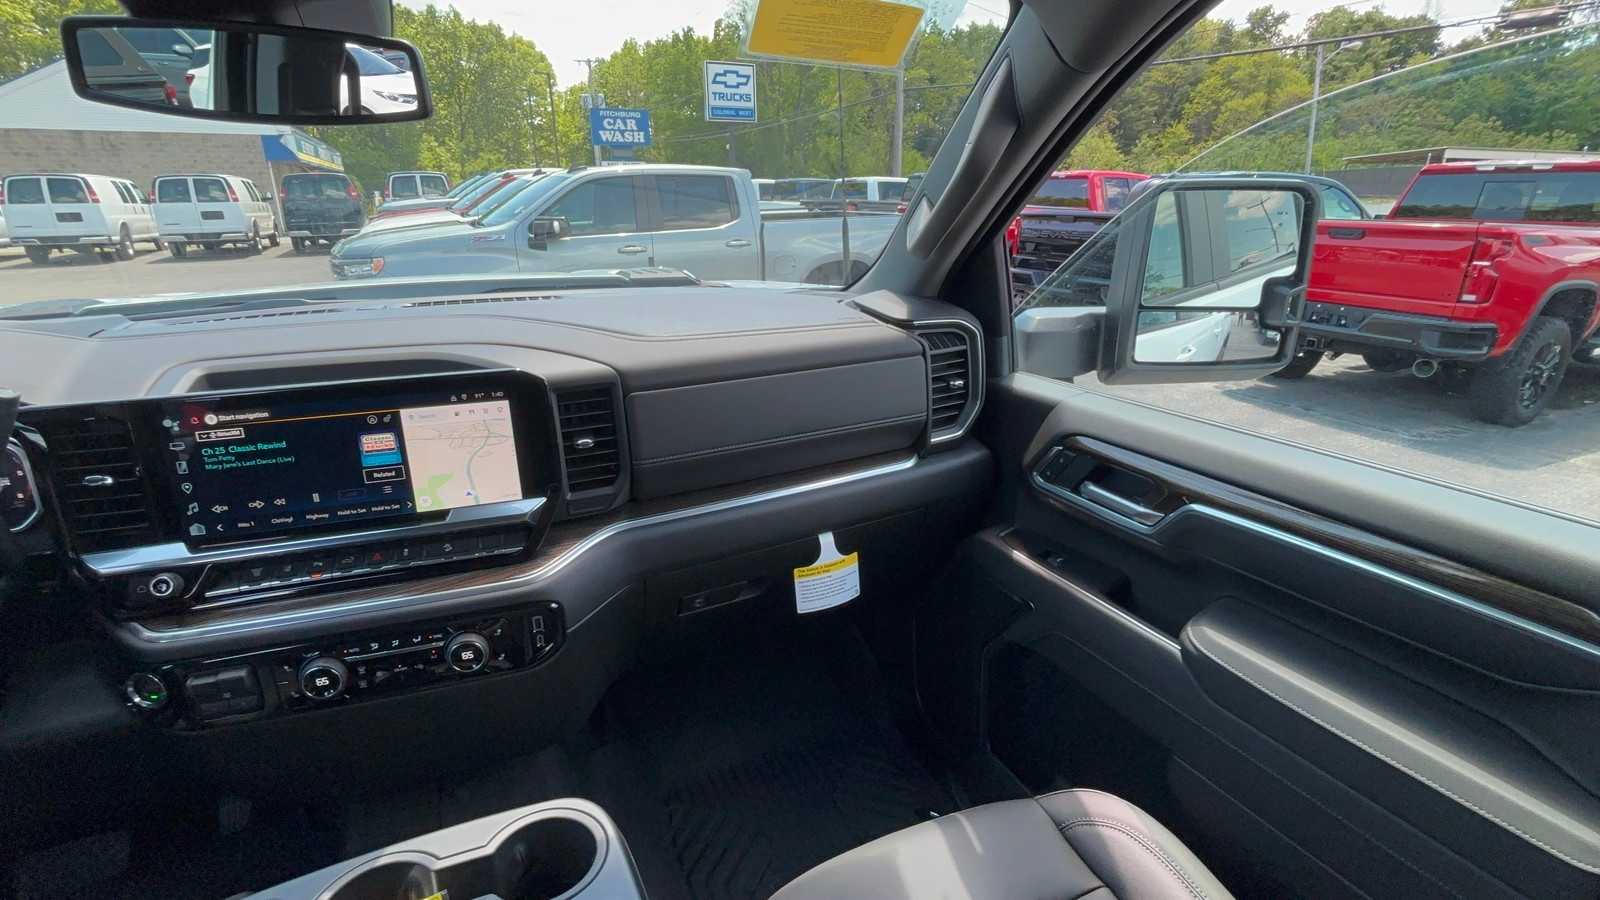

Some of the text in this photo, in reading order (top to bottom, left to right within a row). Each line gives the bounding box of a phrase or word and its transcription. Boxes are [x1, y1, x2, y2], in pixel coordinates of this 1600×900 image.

[711, 91, 752, 103] TRUCKS
[599, 110, 641, 118] FITCHBURG
[603, 118, 638, 130] CAR
[598, 130, 645, 143] WASH
[219, 411, 270, 422] Start navigation
[202, 440, 287, 456] Ch 25 Classic Rewind
[205, 463, 222, 471] Mary
[223, 461, 242, 470] Jane's
[257, 458, 277, 466] Dance
[373, 470, 396, 478] Related
[461, 650, 474, 661] 65
[315, 675, 330, 687] 65
